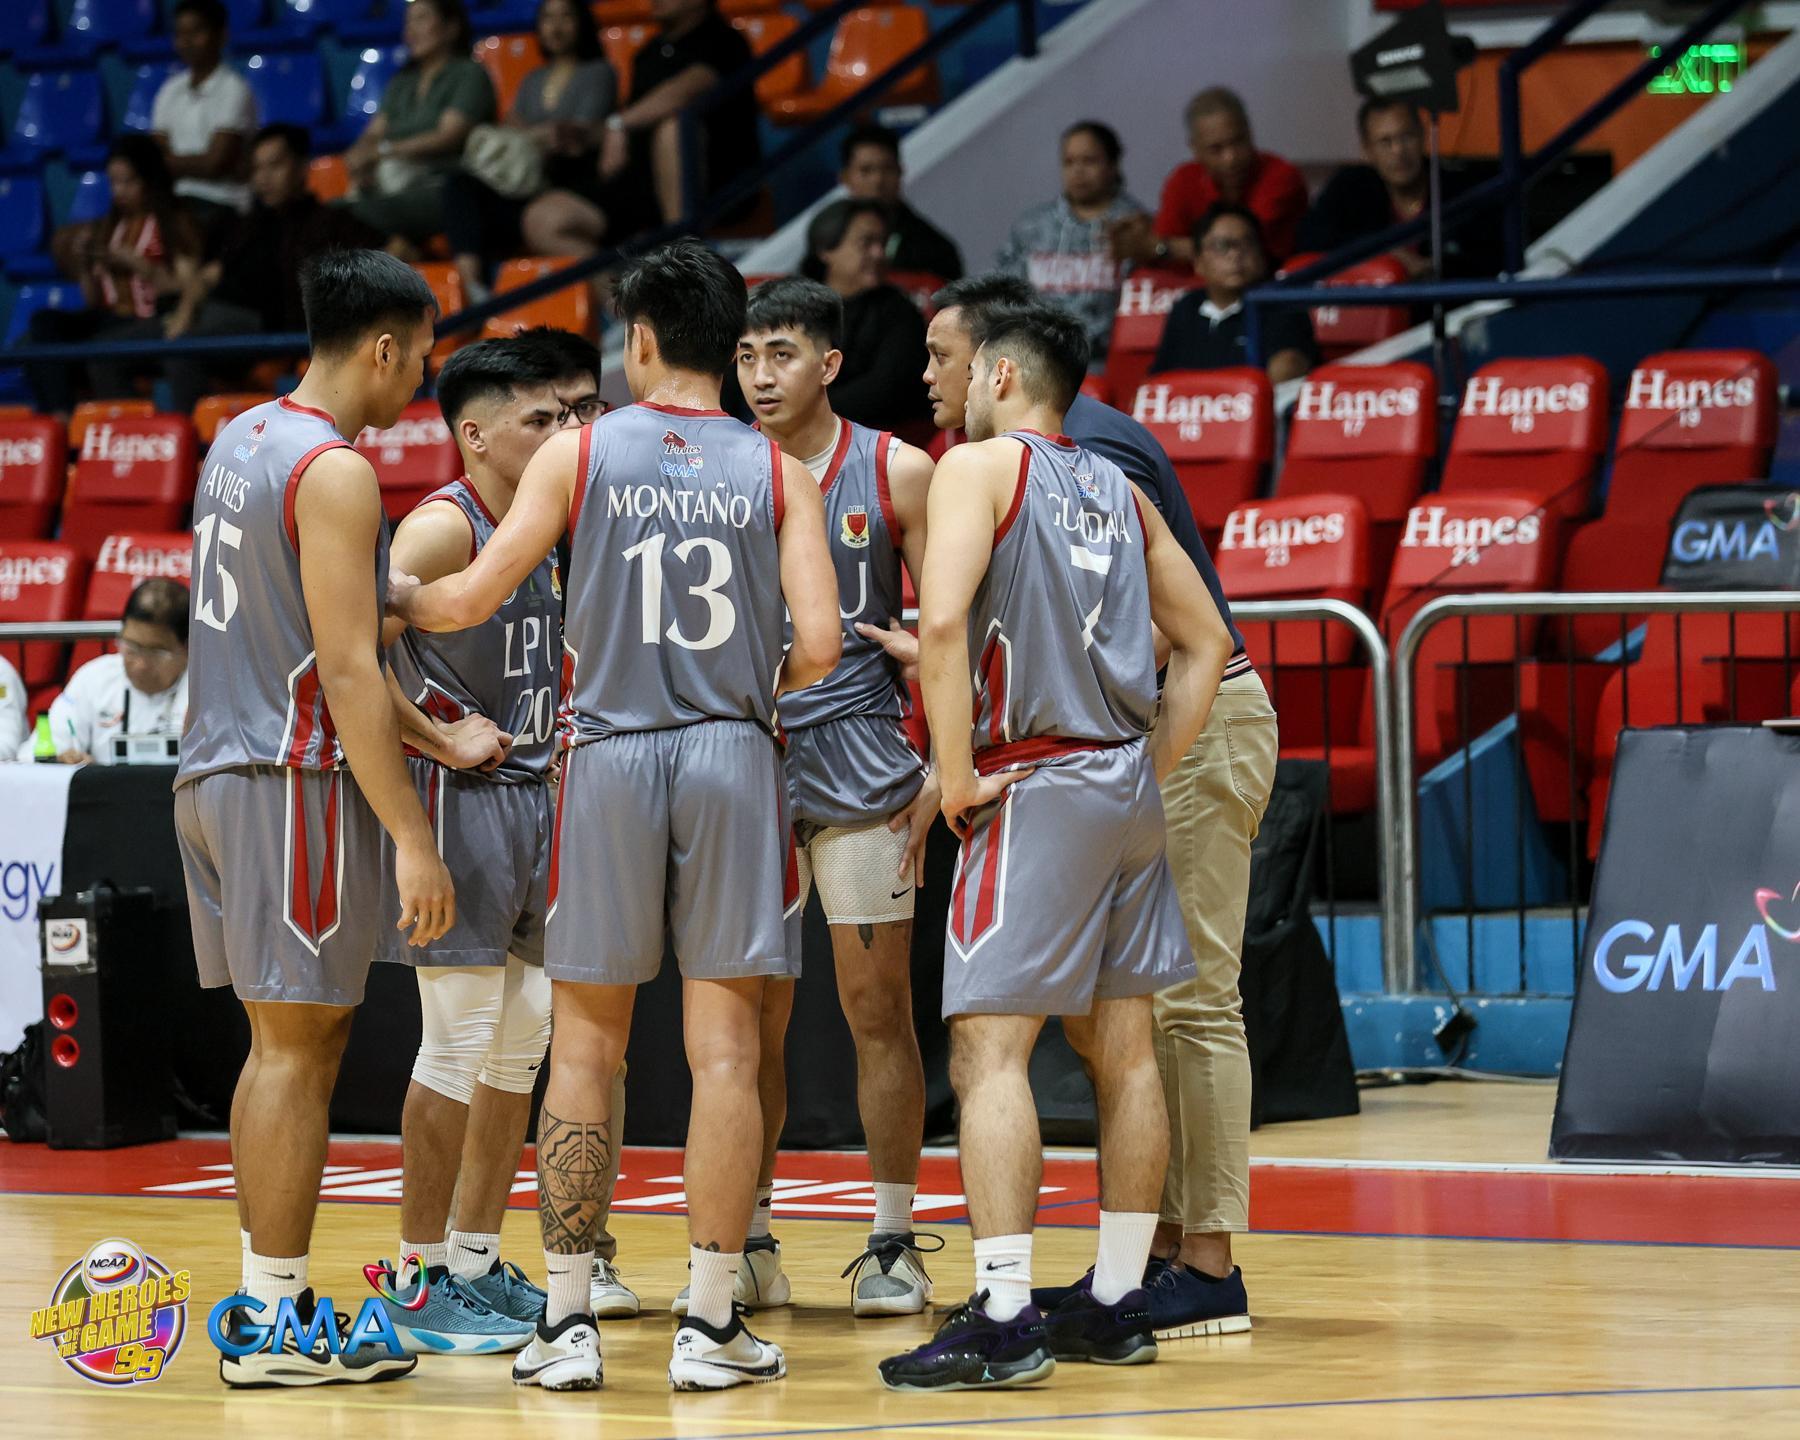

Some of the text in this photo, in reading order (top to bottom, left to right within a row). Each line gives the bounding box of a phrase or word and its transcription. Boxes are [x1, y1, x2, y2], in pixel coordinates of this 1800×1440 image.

[1132, 384, 1253, 423] Hanes
[1296, 381, 1420, 420] Hanes
[1461, 376, 1589, 416] Hanes
[1625, 368, 1755, 410] Hanes
[81, 423, 177, 461] Hanes
[203, 463, 251, 513] AVILES
[661, 461, 698, 477] GMA
[607, 481, 751, 528] MONTAÑO
[1219, 508, 1345, 549] Hanes
[1401, 506, 1540, 547] Hanes
[1672, 520, 1780, 562] GMA
[0, 557, 67, 584] anes
[194, 513, 243, 632] 15
[621, 532, 736, 650] 13
[512, 687, 554, 747] 20
[0, 862, 55, 921] gy
[1593, 919, 1777, 994] GMA
